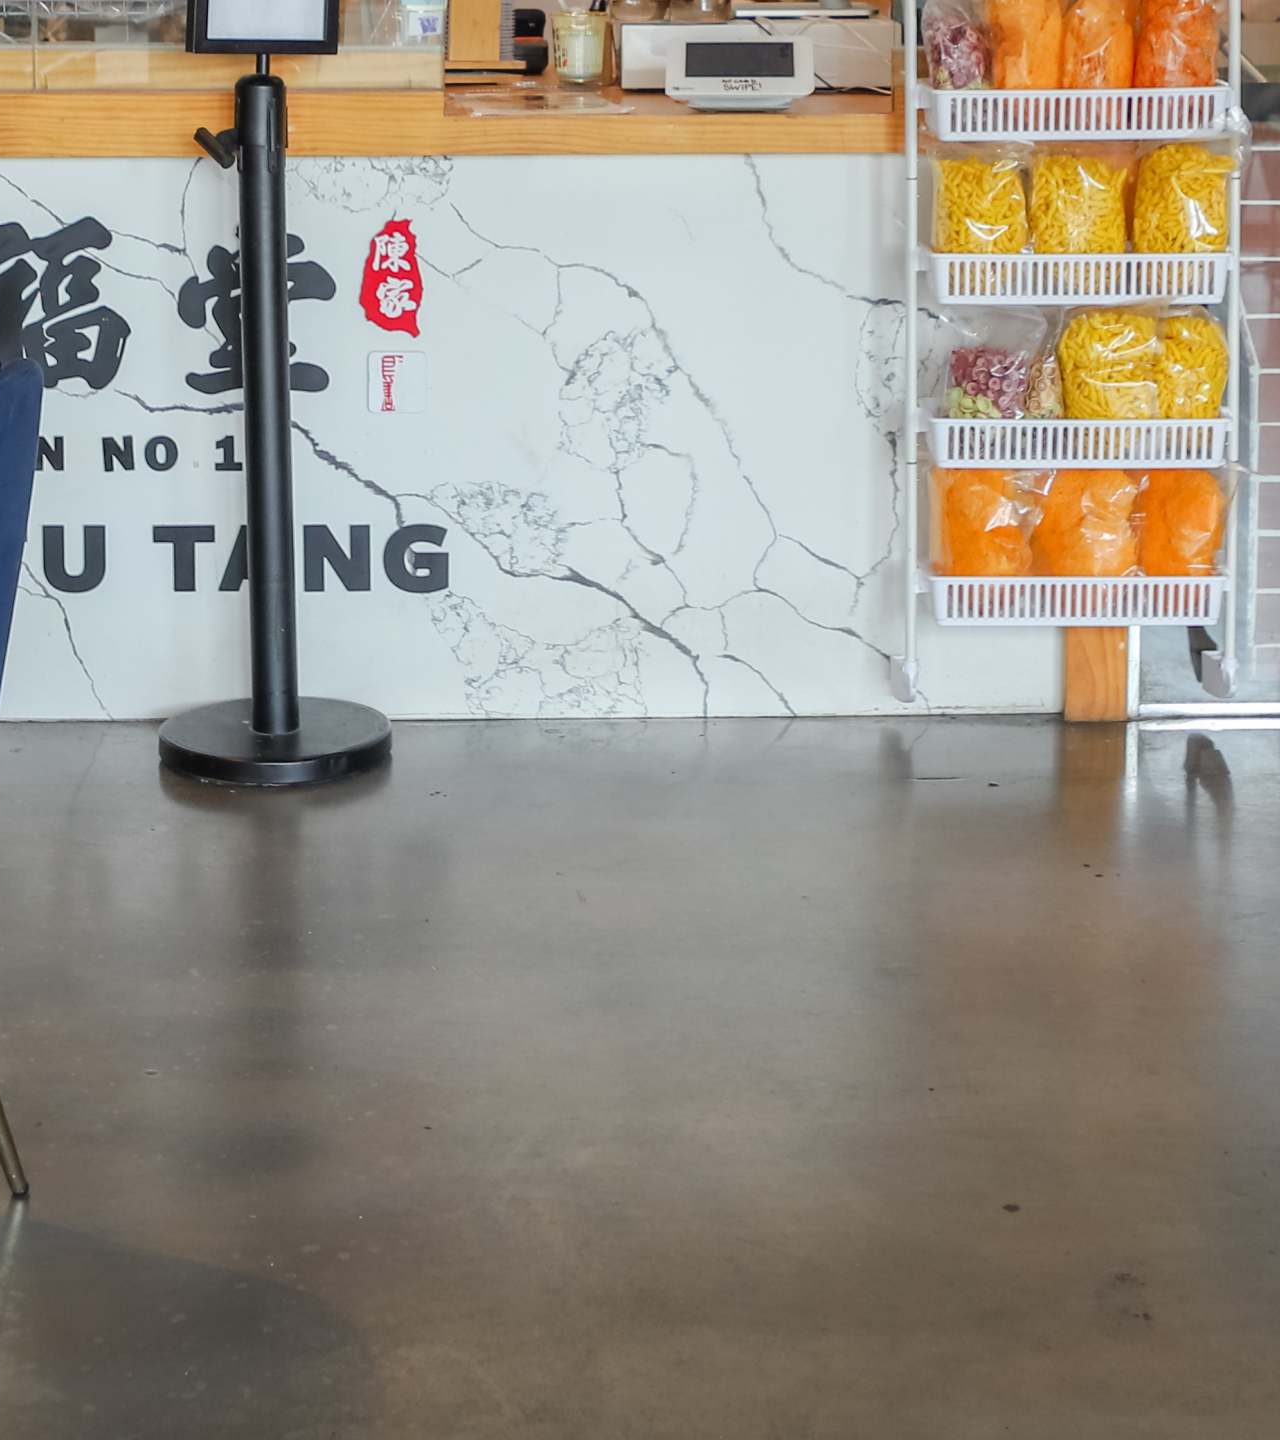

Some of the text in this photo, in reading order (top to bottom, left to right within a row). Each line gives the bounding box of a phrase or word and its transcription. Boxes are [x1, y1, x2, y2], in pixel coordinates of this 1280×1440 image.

[372, 231, 417, 319] 陳家
[102, 435, 179, 472] NO
[214, 435, 244, 471] 1
